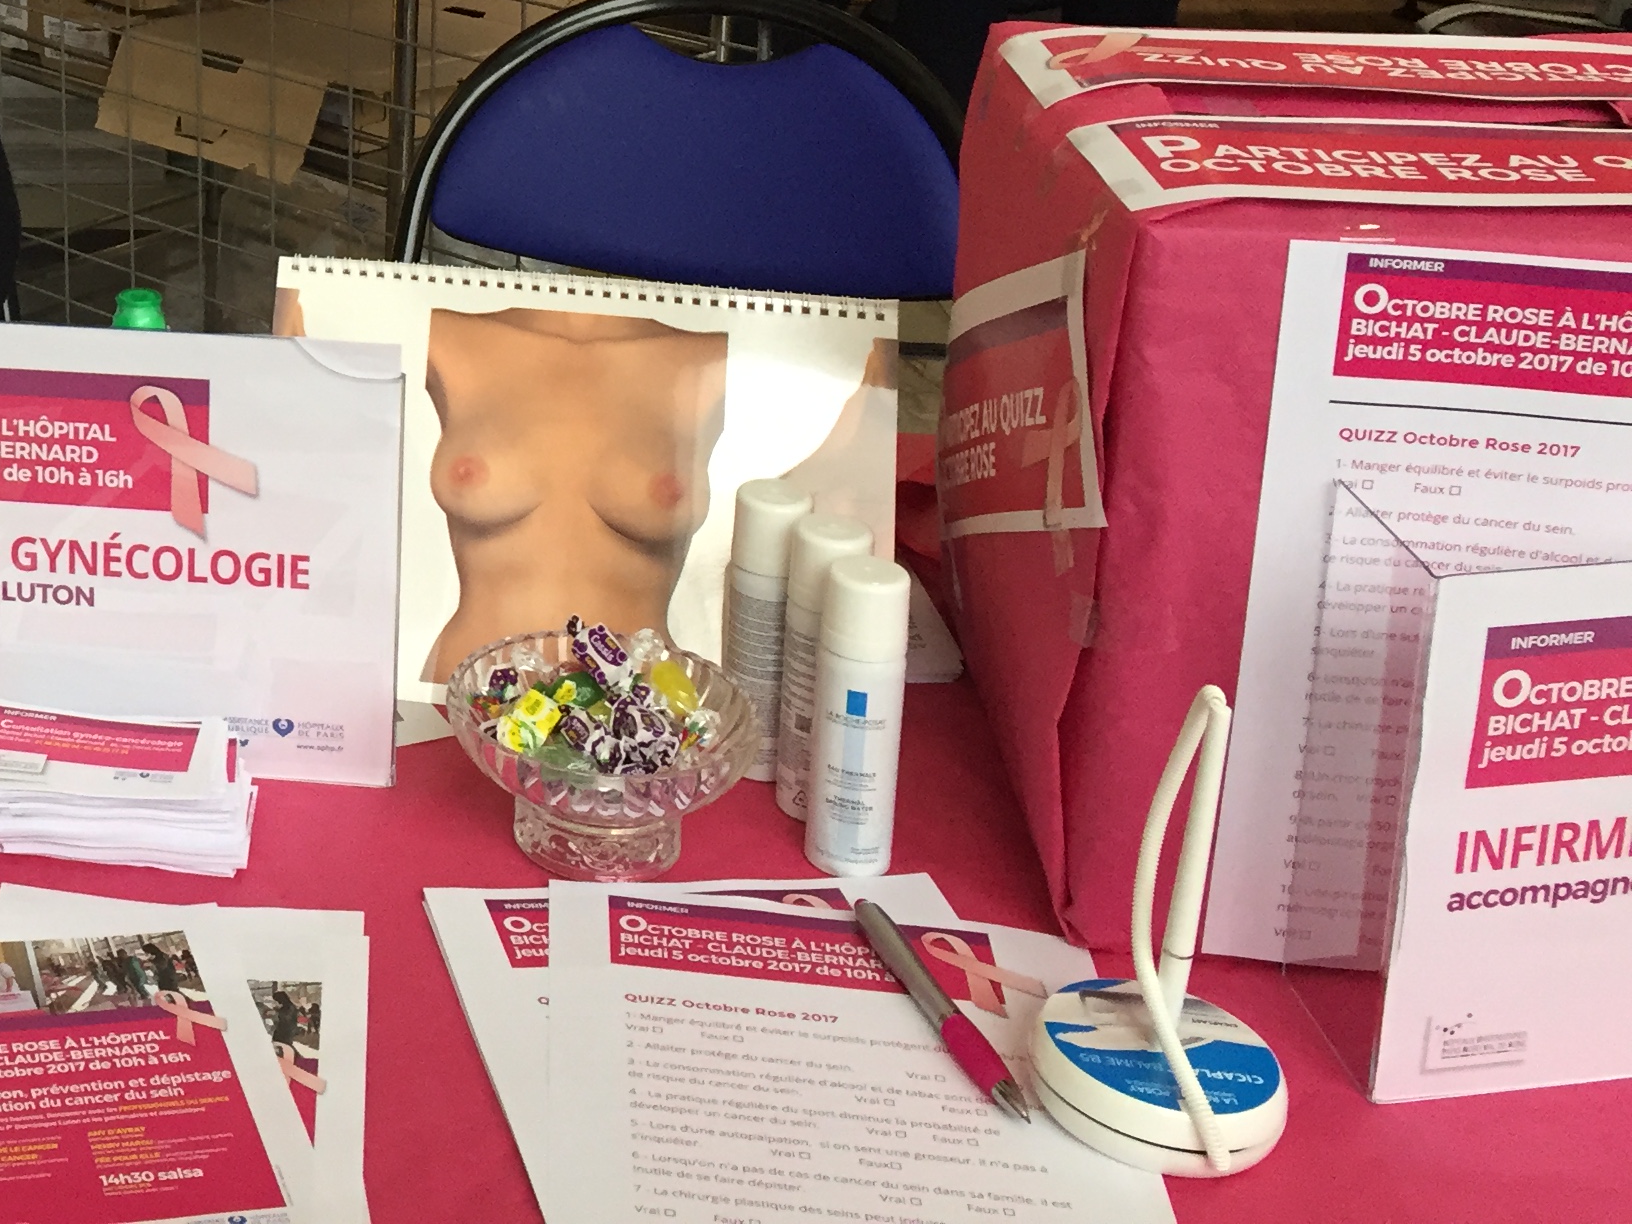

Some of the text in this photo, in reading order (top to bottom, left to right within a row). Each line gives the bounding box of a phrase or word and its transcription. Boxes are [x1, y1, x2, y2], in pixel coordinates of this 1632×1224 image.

[1141, 134, 1494, 167] PARTICIPEZ
[1506, 153, 1577, 168] AU
[1159, 157, 1597, 182] OCTOBRE ROSE
[1369, 257, 1447, 272] INFORMER
[1353, 283, 1483, 320] OCTOBRE
[1486, 304, 1554, 326] ROSE
[1556, 306, 1576, 328] À
[1350, 318, 1438, 339] BICHAT
[1, 415, 116, 441] L'HÔPITAL
[1338, 427, 1580, 457] QUIZZ Octobre Rose 2017
[3, 463, 31, 481] de
[34, 465, 73, 485] 10h
[77, 467, 91, 485] à
[94, 469, 132, 488] 16h
[1350, 459, 1602, 489] Manger équilibré et éviter le surpoids
[1414, 483, 1445, 496] Faux
[1396, 511, 1448, 525] protège
[1452, 513, 1470, 524] du
[1473, 517, 1519, 529] cancer
[1522, 520, 1540, 531] du
[11, 532, 309, 589] GYNÉCOLOGIE
[1, 580, 94, 606] LUTON
[1510, 630, 1594, 649] INFORMER
[1492, 670, 1632, 707] OCTOBRE
[1487, 708, 1587, 736] BICHAT
[1477, 736, 1548, 768] jeudi
[1550, 736, 1568, 756] 5
[1455, 816, 1632, 874] INFIRM
[618, 914, 875, 956] OCTOBRE ROSE À L'HÔP
[620, 932, 883, 969] BICHAT CLAUDE-BERNAR
[624, 993, 838, 1023] QUIZZ Octobre Rose 2017
[11, 1039, 61, 1052] ROSE
[64, 1035, 78, 1049] À
[79, 1030, 170, 1047] L'HÔPITAL
[30, 1079, 124, 1097] prévention
[128, 1077, 146, 1087] et
[149, 1070, 231, 1087] dépistage
[98, 1167, 203, 1186] 14h30 salsa
